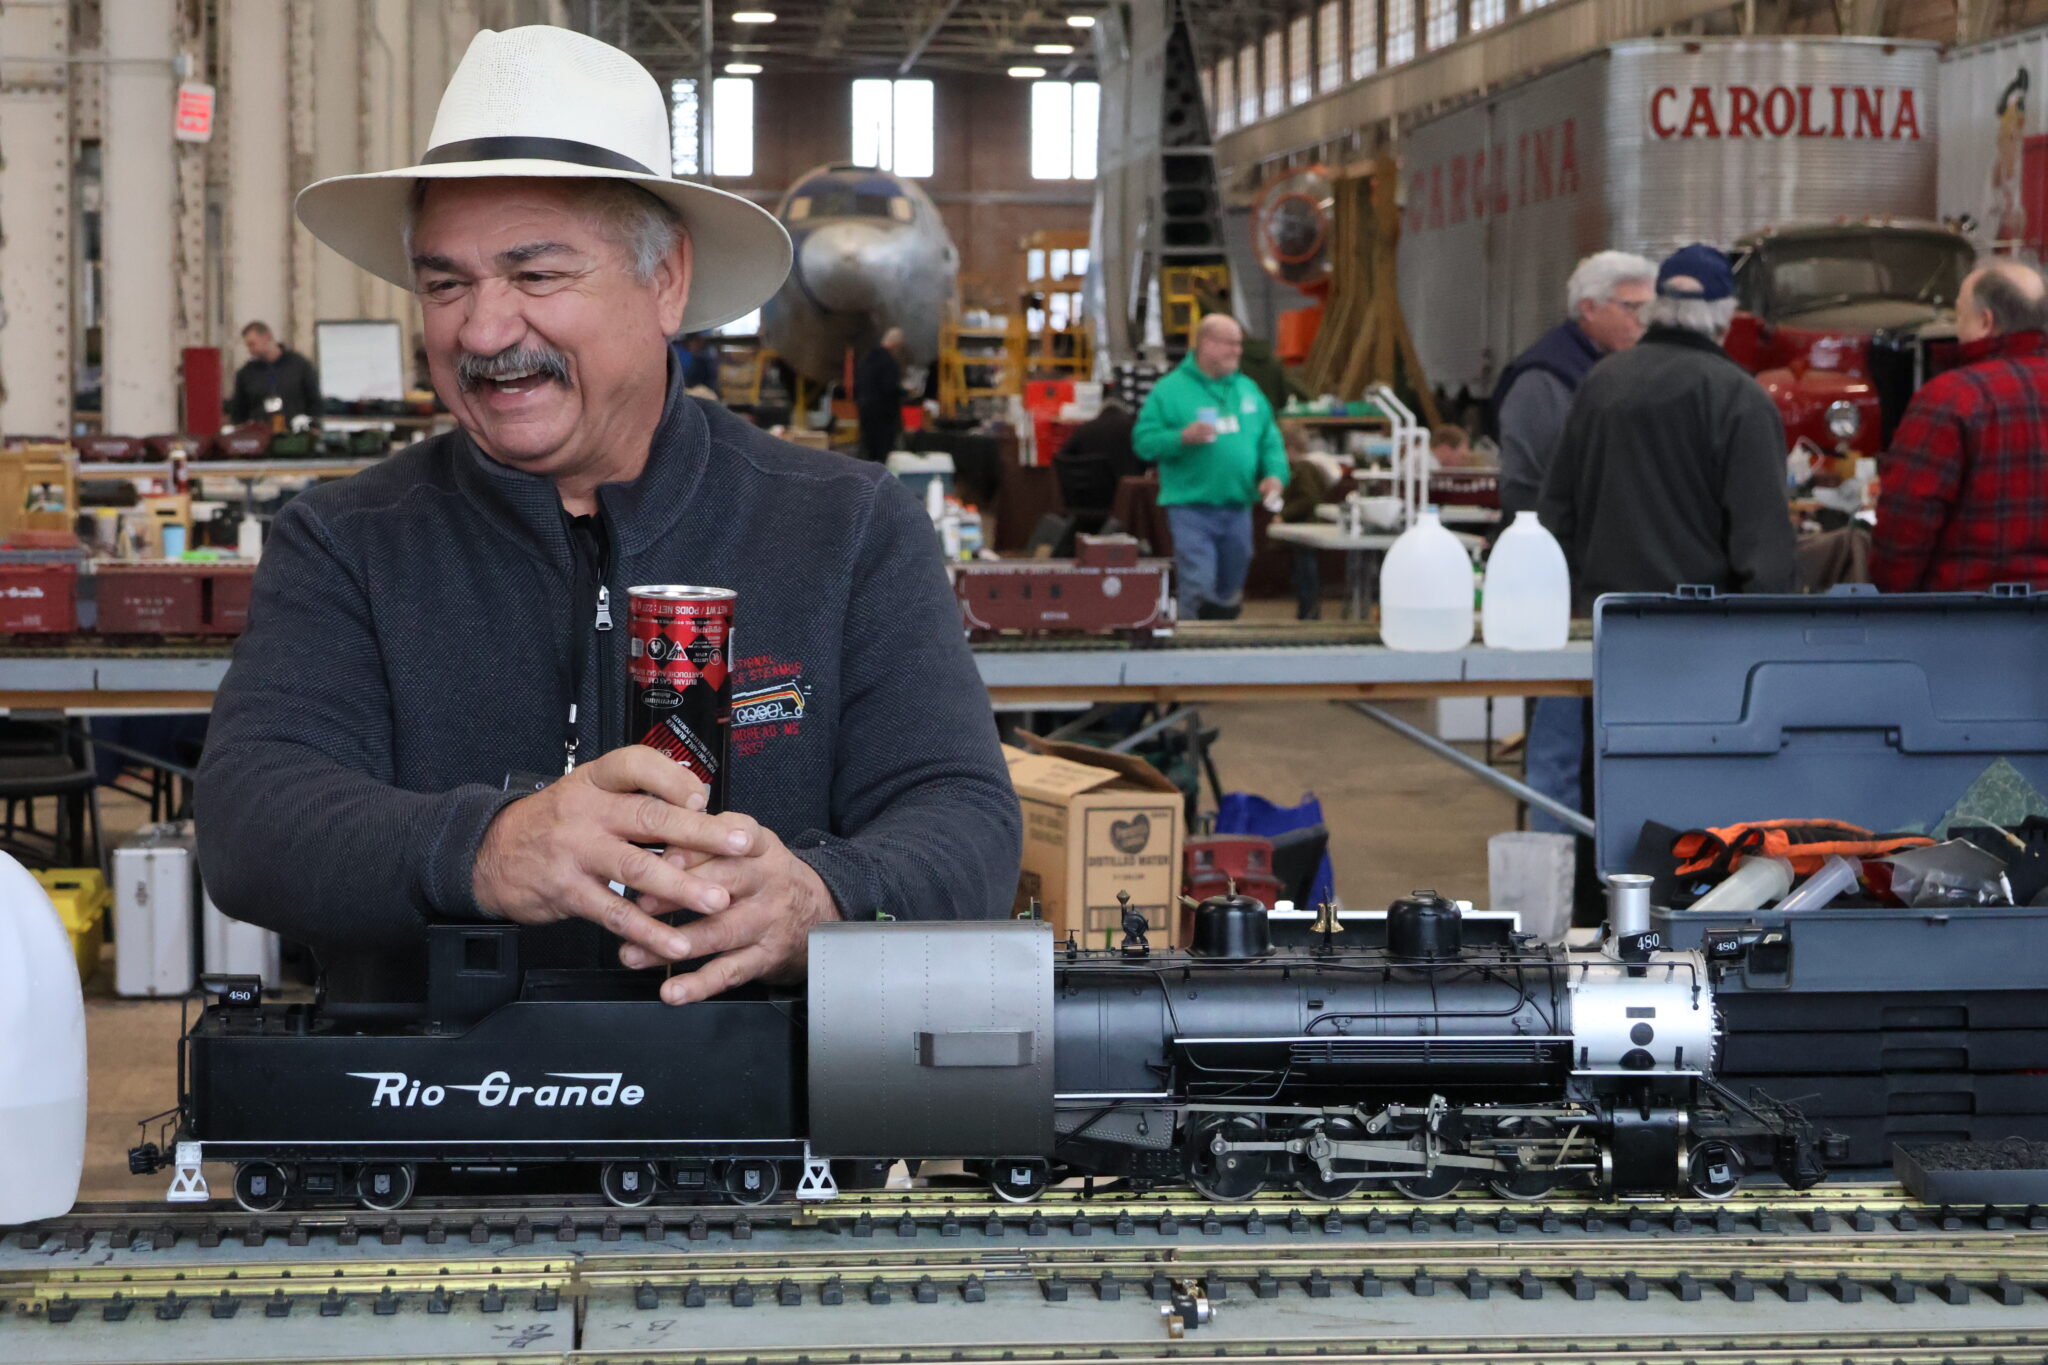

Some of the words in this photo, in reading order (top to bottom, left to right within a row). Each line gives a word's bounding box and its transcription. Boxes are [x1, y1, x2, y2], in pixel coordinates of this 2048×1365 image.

[1651, 86, 1920, 139] CAROLINA
[1407, 118, 1580, 232] CAROLINA
[658, 605, 673, 614] NET
[675, 606, 699, 615] POIDS
[669, 671, 704, 679] CARTOUCHE
[674, 678, 698, 686] BUTANE
[645, 697, 679, 705] premium
[666, 718, 687, 741] BURNER
[684, 738, 708, 764] PORTABLE
[1637, 933, 1660, 951] 480
[1716, 941, 1737, 951] 480
[229, 990, 251, 1001] 480
[345, 1071, 446, 1107] Rio
[445, 1070, 646, 1107] Grande
